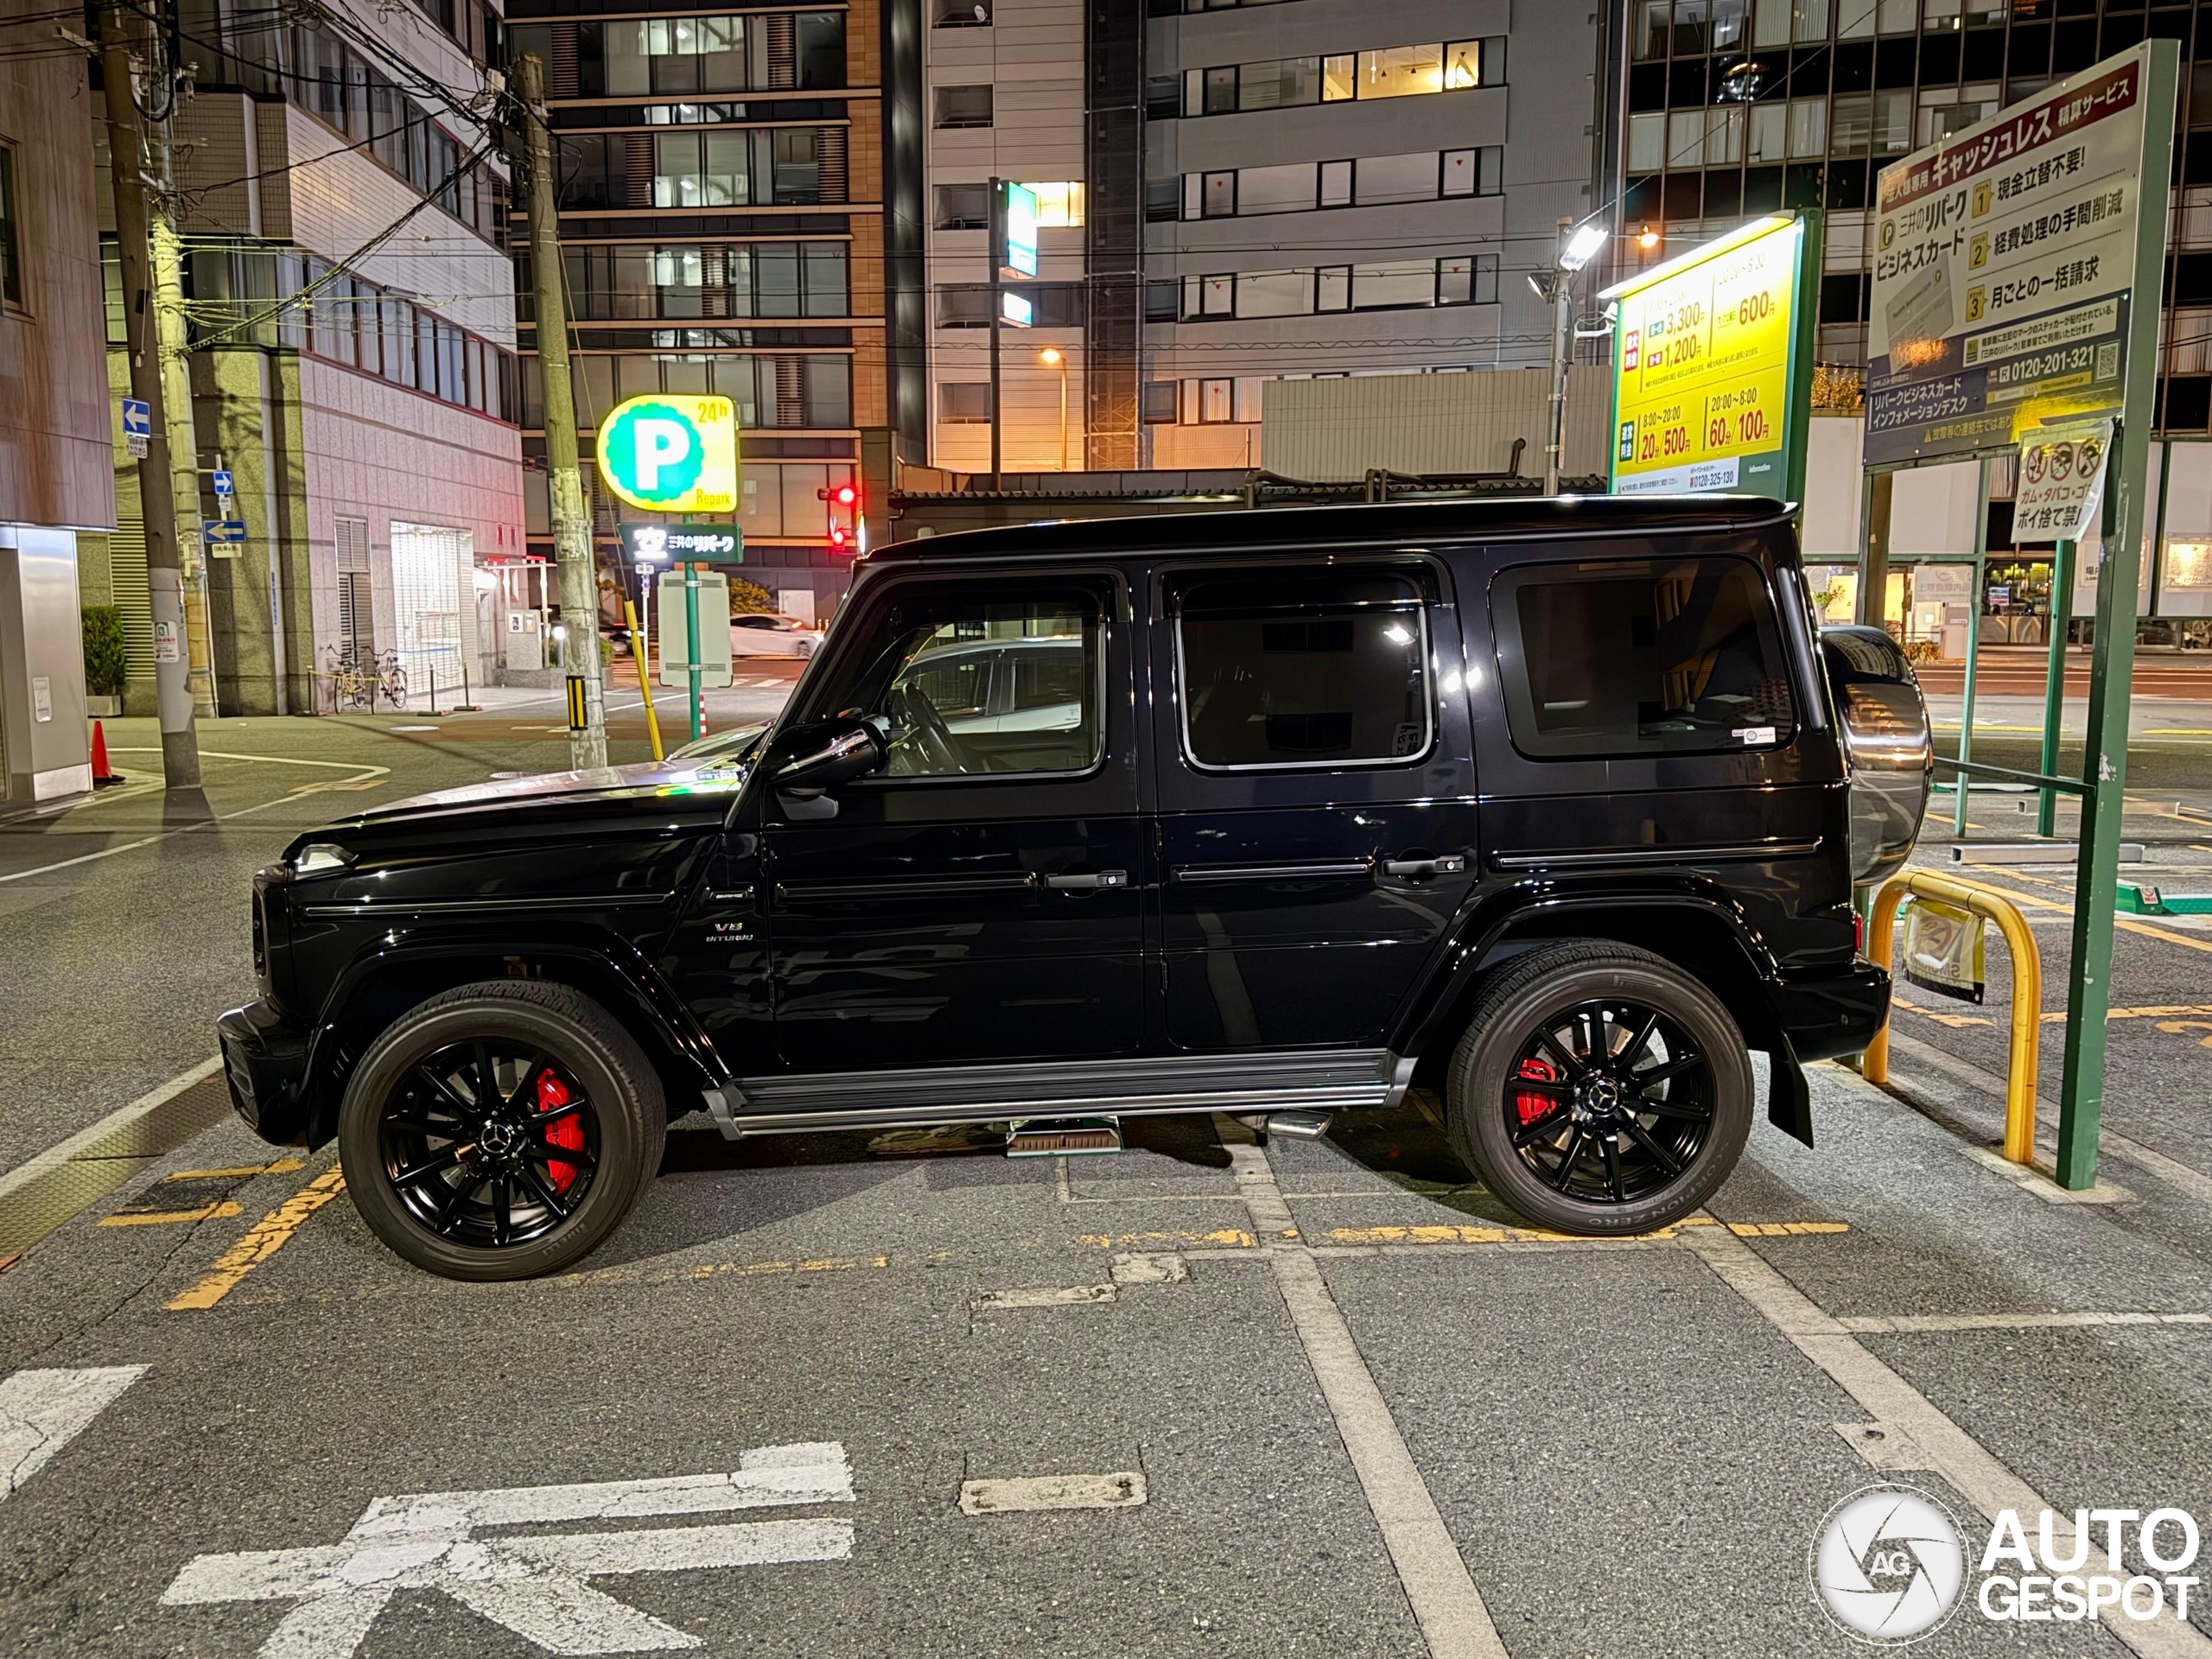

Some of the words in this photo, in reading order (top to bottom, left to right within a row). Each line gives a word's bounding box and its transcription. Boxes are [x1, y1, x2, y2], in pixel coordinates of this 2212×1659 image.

[1932, 105, 2053, 188] キャッシュレス
[2057, 78, 2130, 128] 精算サービス
[1998, 145, 2086, 201] 現金立替不要!
[1899, 189, 1967, 238] 三井のリパーク
[1977, 193, 1984, 213] 1
[1993, 188, 2123, 257] 経費処理の手間削減
[1877, 226, 1966, 283] ビジネスカード
[1974, 245, 1982, 266] 2
[1991, 255, 2100, 309] 月ごとの一括請求
[1970, 298, 1979, 318] 3
[2012, 344, 2095, 382] 0120-201-321
[1874, 377, 1962, 411] リパークビジネスカード
[1872, 395, 1968, 429] インフォメーションデスク
[633, 418, 690, 491] P
[696, 489, 731, 506] Repark
[2017, 505, 2082, 529] ポイ捨て禁
[668, 534, 734, 553] 三井のリパーク
[706, 934, 753, 943] BITURBO
[715, 922, 742, 931] V8
